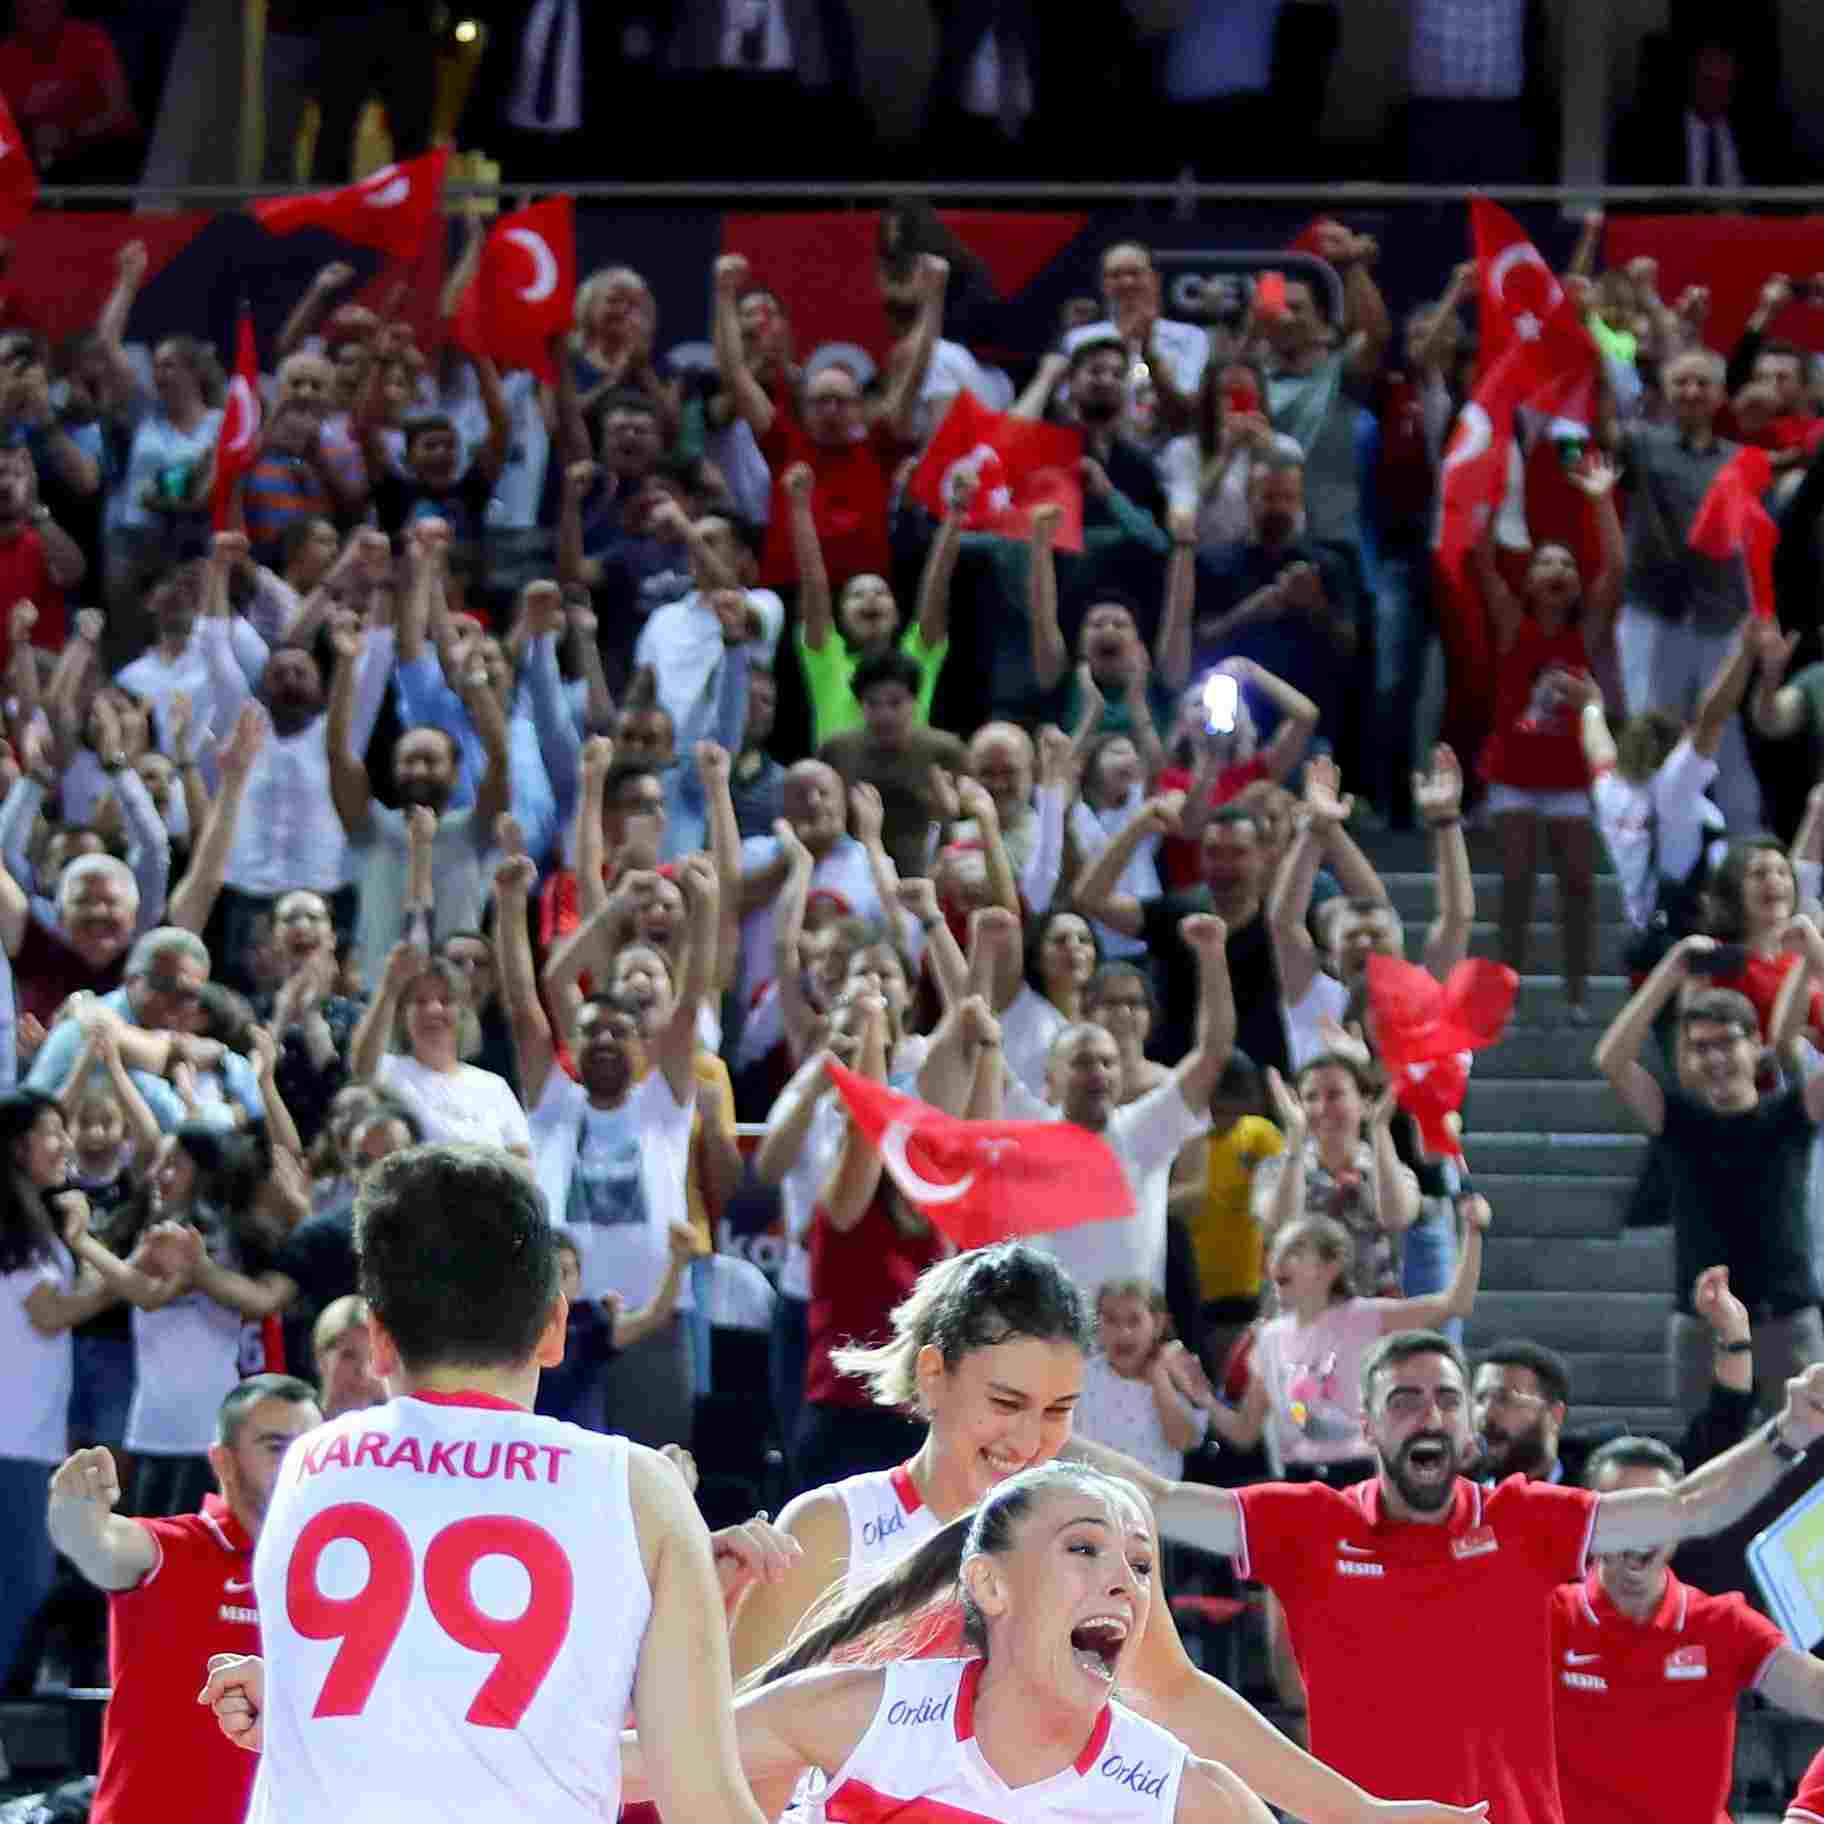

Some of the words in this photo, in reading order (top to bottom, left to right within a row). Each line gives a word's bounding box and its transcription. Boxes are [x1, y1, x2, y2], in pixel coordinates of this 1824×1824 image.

[296, 1431, 572, 1485] KARAKURT
[862, 1505, 906, 1545] Okid
[285, 1501, 575, 1731] 99
[888, 1694, 953, 1726] Orkid
[1101, 1754, 1171, 1799] Orkid
